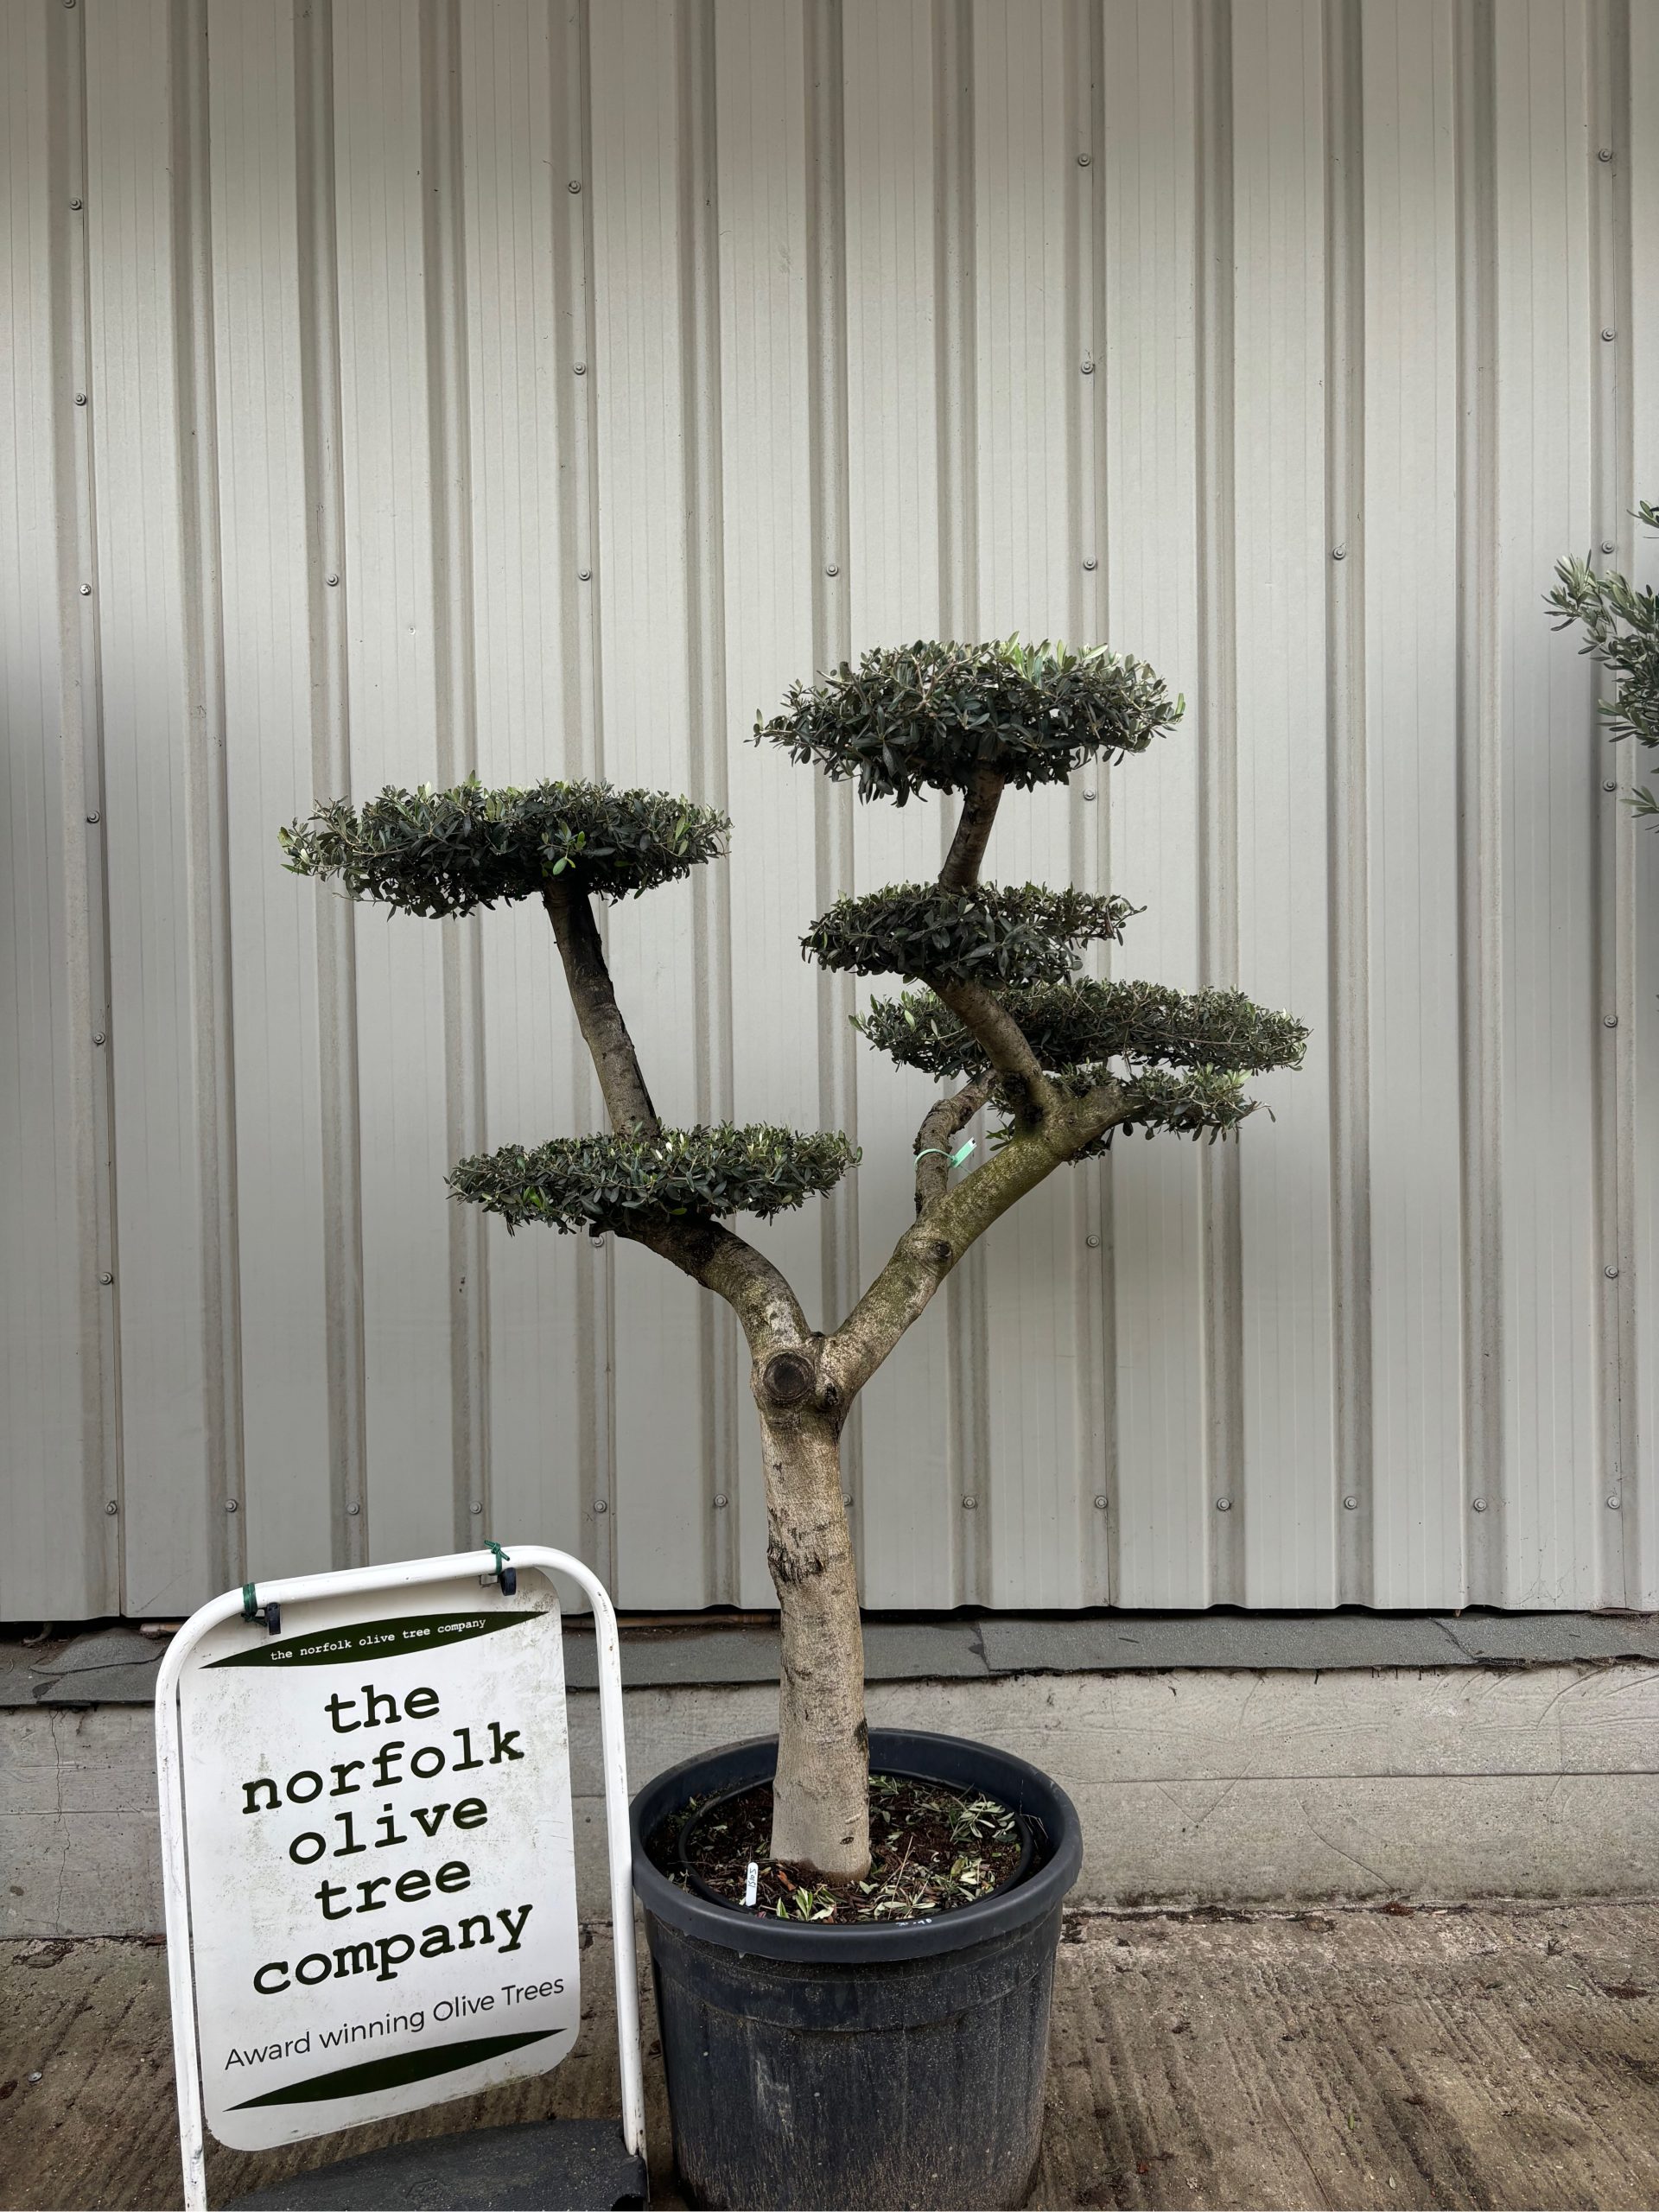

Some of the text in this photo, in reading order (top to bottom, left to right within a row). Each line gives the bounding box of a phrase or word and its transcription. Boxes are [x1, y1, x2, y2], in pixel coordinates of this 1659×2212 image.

[270, 1618, 486, 1662] the norfolk olive tree company
[324, 1684, 440, 1734] the
[241, 1721, 524, 1815] norfolk
[289, 1797, 488, 1866] olive
[315, 1860, 471, 1921] tree
[253, 1904, 533, 1995] company
[225, 1978, 564, 2071] Award winning Olive Trees
